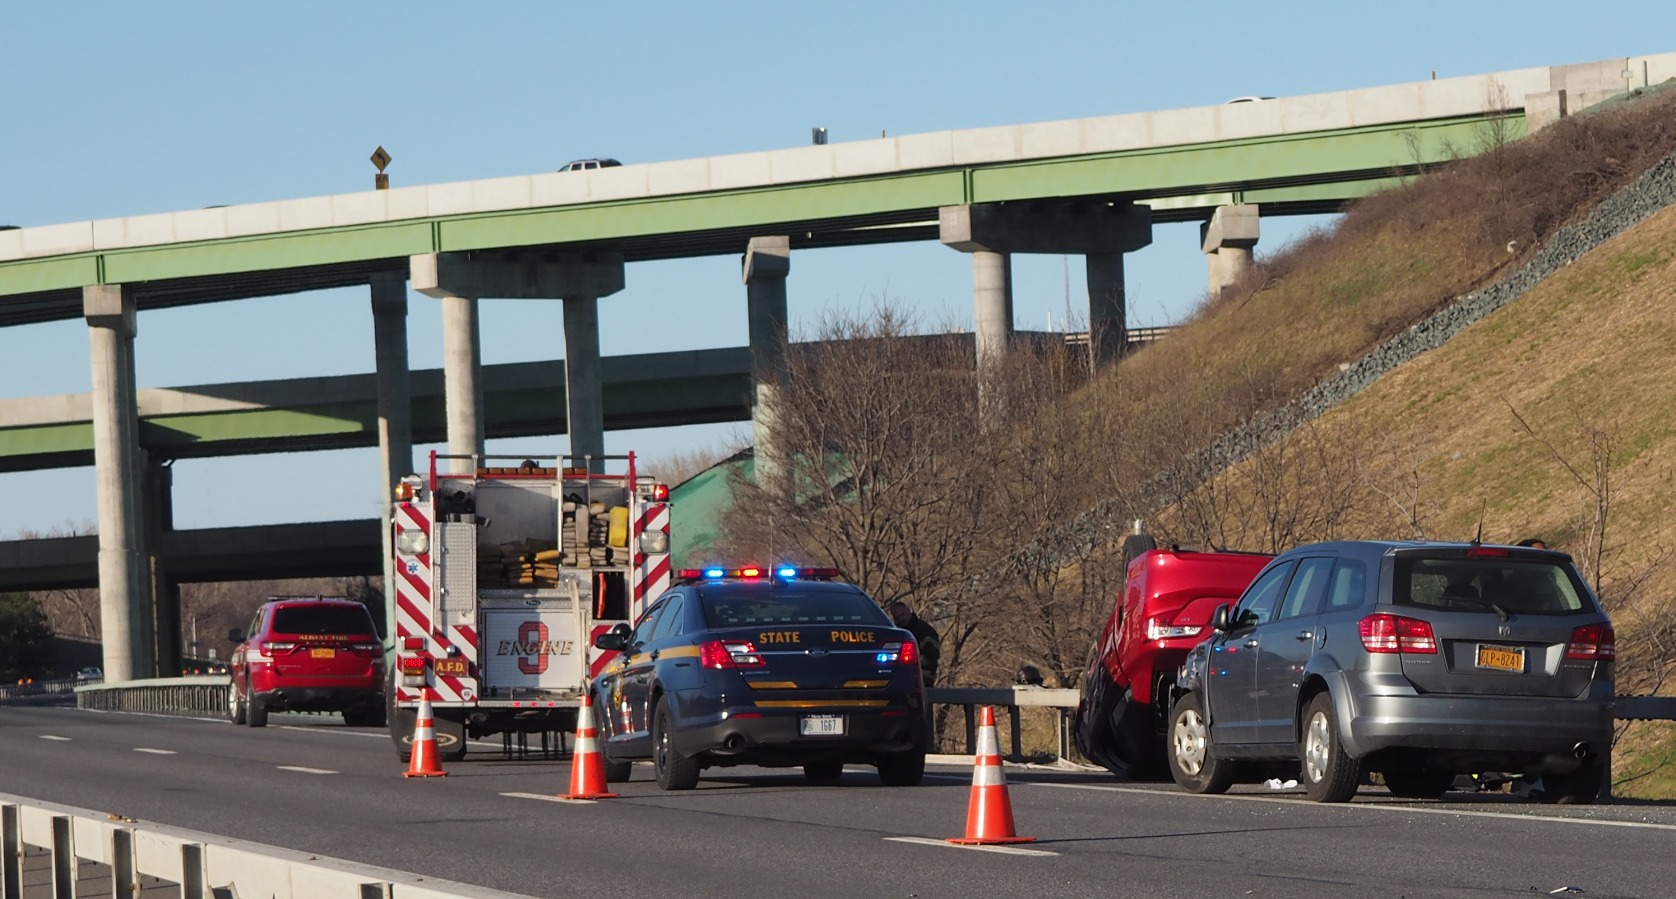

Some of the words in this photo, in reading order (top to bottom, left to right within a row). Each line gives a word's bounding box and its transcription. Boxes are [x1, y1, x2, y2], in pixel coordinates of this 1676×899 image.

[759, 631, 800, 644] STATE
[831, 631, 876, 643] POLICE
[496, 640, 573, 656] ENGINE
[518, 621, 549, 675] 9
[436, 661, 465, 673] A.F.D.
